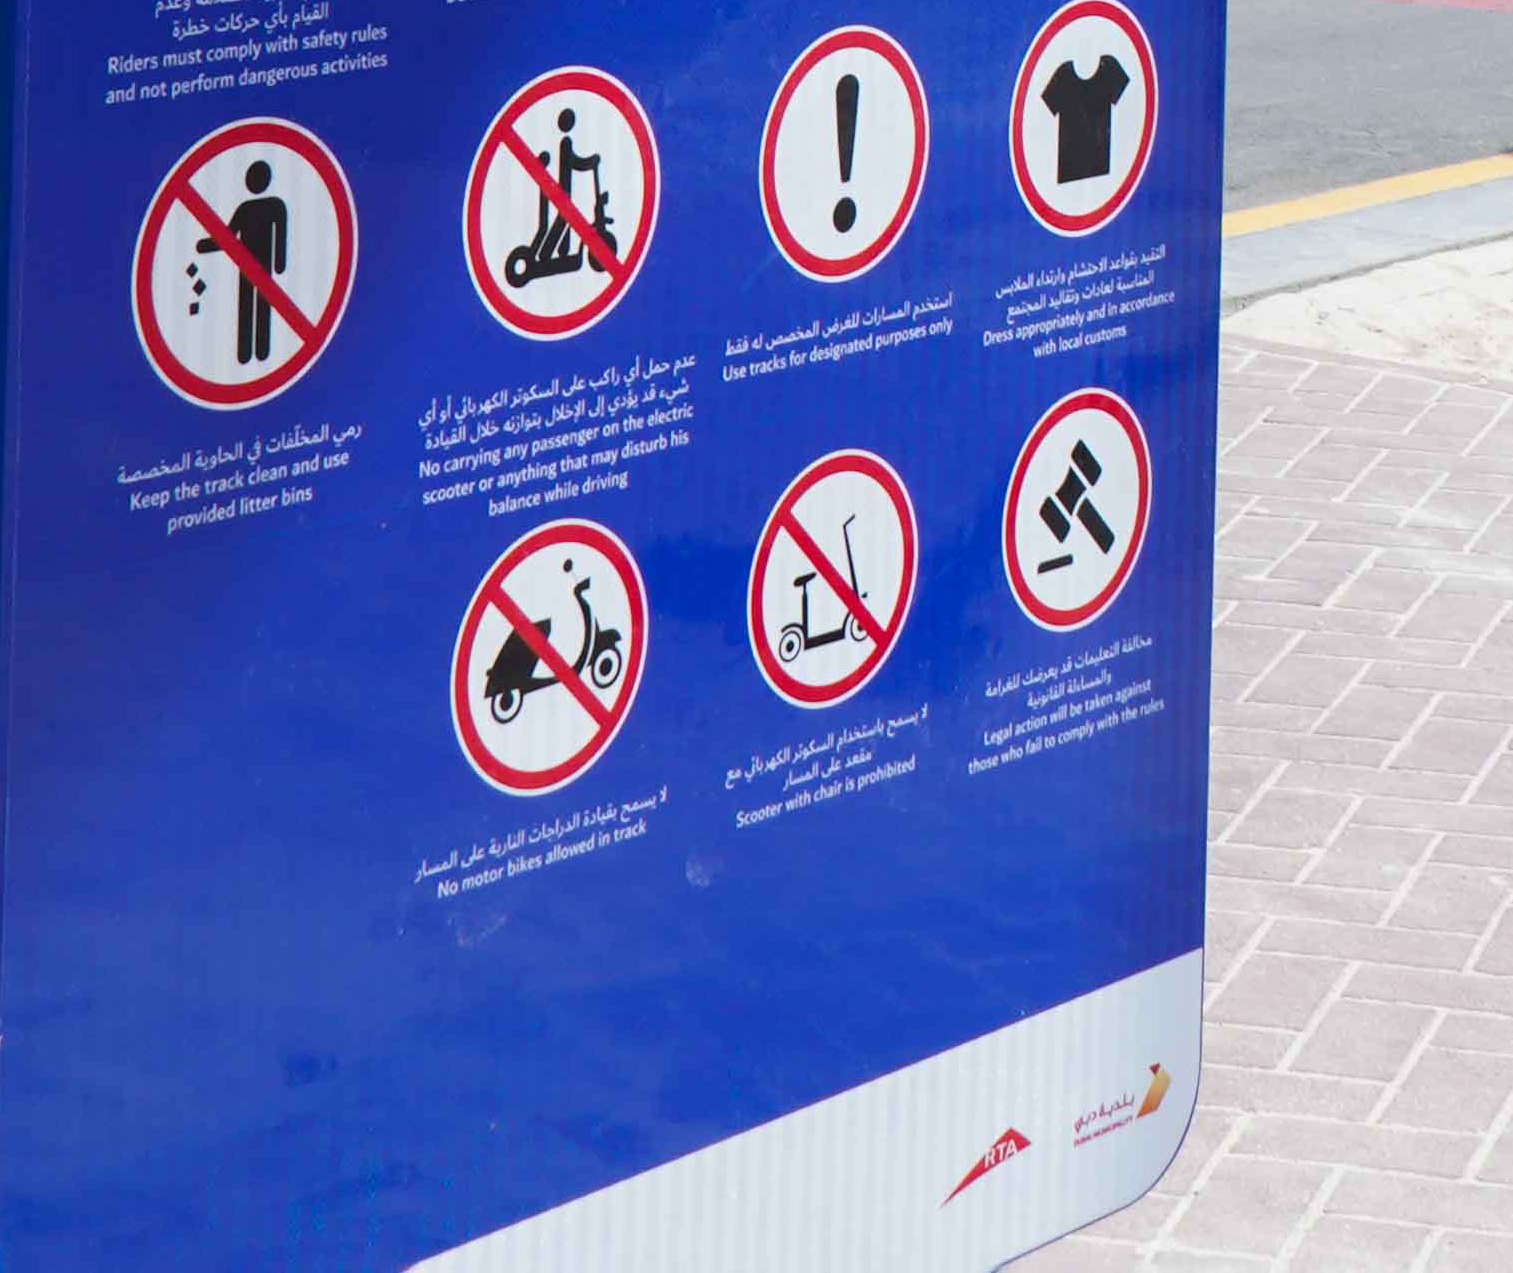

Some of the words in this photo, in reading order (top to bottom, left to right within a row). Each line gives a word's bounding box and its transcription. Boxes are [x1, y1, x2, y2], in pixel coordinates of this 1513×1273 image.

[106, 83, 136, 104] and
[140, 82, 167, 99] not
[171, 73, 235, 99] perform
[239, 63, 319, 87] dangerous
[321, 52, 388, 75] activities
[108, 54, 159, 74] Riders
[163, 48, 203, 67] must
[206, 38, 263, 62] comply
[265, 34, 299, 54] with
[303, 30, 348, 50] safety
[351, 24, 388, 43] rules
[983, 322, 1015, 346] Dress
[1016, 310, 1085, 341] appropriately
[1086, 303, 1106, 322] and
[1107, 302, 1118, 316] in
[1119, 292, 1175, 314] accordance
[1033, 338, 1057, 358] with
[1059, 332, 1084, 352] local
[1084, 326, 1127, 346] customs
[723, 365, 747, 382] Use
[749, 354, 787, 376] tracks
[789, 350, 808, 367] for
[809, 333, 873, 362] designated
[875, 326, 927, 351] purposes
[929, 317, 953, 335] only
[419, 460, 441, 478] No
[443, 448, 501, 473] carrying
[504, 443, 529, 461] any
[532, 427, 600, 457] passenger
[603, 422, 620, 437] on
[623, 414, 645, 432] the
[647, 403, 694, 427] electric
[423, 482, 476, 505] scooter
[479, 477, 495, 492] or
[497, 462, 558, 488] anything
[560, 454, 589, 473] that
[591, 449, 619, 466] may
[621, 434, 668, 459] disturb
[671, 430, 690, 447] his
[131, 490, 171, 510] Keep
[175, 481, 201, 501] the
[205, 470, 244, 494] track
[248, 465, 288, 486] clean
[291, 453, 320, 476] and
[323, 452, 350, 470] use
[489, 493, 542, 516] balance
[544, 481, 580, 503] while
[582, 471, 629, 494] driving
[168, 499, 236, 535] provided
[240, 495, 279, 515] litter
[282, 487, 314, 506] bins
[968, 755, 999, 775] those
[1001, 745, 1024, 764] who
[1025, 736, 1043, 754] fail
[1044, 736, 1056, 749] to
[1058, 720, 1095, 744] comply
[1096, 711, 1119, 731] with
[1121, 706, 1139, 722] the
[1140, 698, 1165, 716] rules
[984, 722, 1013, 746] Legal
[1015, 715, 1048, 736] action
[1050, 704, 1068, 724] will
[1069, 702, 1083, 718] be
[1085, 694, 1113, 712] taken
[1115, 679, 1151, 704] against
[737, 802, 783, 828] Scooter
[785, 790, 812, 811] with
[813, 780, 843, 802] chair
[845, 776, 855, 792] is
[857, 754, 916, 791] prohibited
[438, 880, 459, 898] No
[462, 867, 505, 891] motor
[507, 854, 543, 877] bikes
[545, 833, 595, 865] allowed
[598, 832, 611, 847] in
[614, 818, 647, 842] track
[983, 1138, 1019, 1169] RTA
